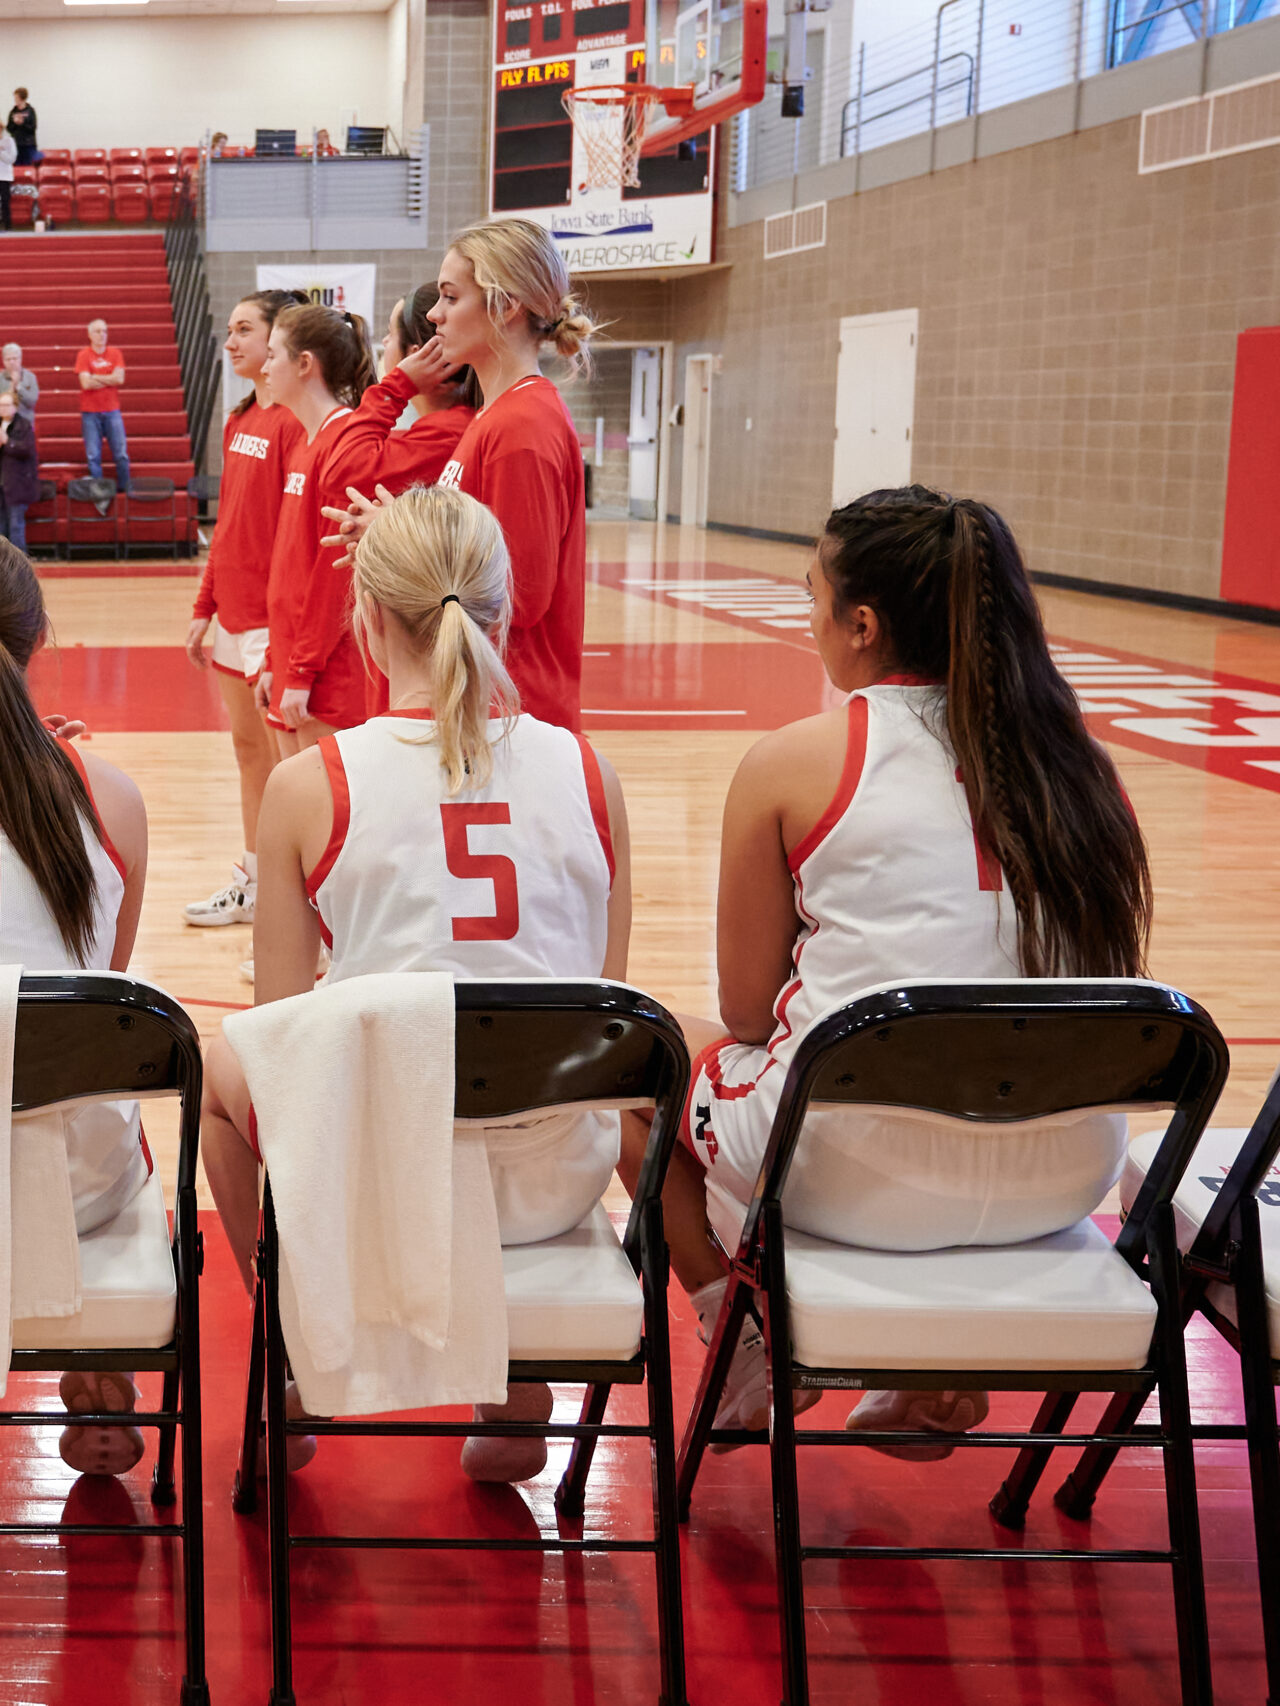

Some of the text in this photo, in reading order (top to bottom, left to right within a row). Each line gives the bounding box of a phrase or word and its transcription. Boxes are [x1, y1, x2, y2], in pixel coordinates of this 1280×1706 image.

[505, 7, 532, 21] FOULS
[576, 33, 627, 51] ADVANTAGE
[504, 48, 531, 62] SCORE
[545, 61, 570, 80] PTS
[551, 203, 654, 231] Iowa State Bank
[570, 241, 678, 267] AEROSPACE
[440, 801, 520, 941] 5
